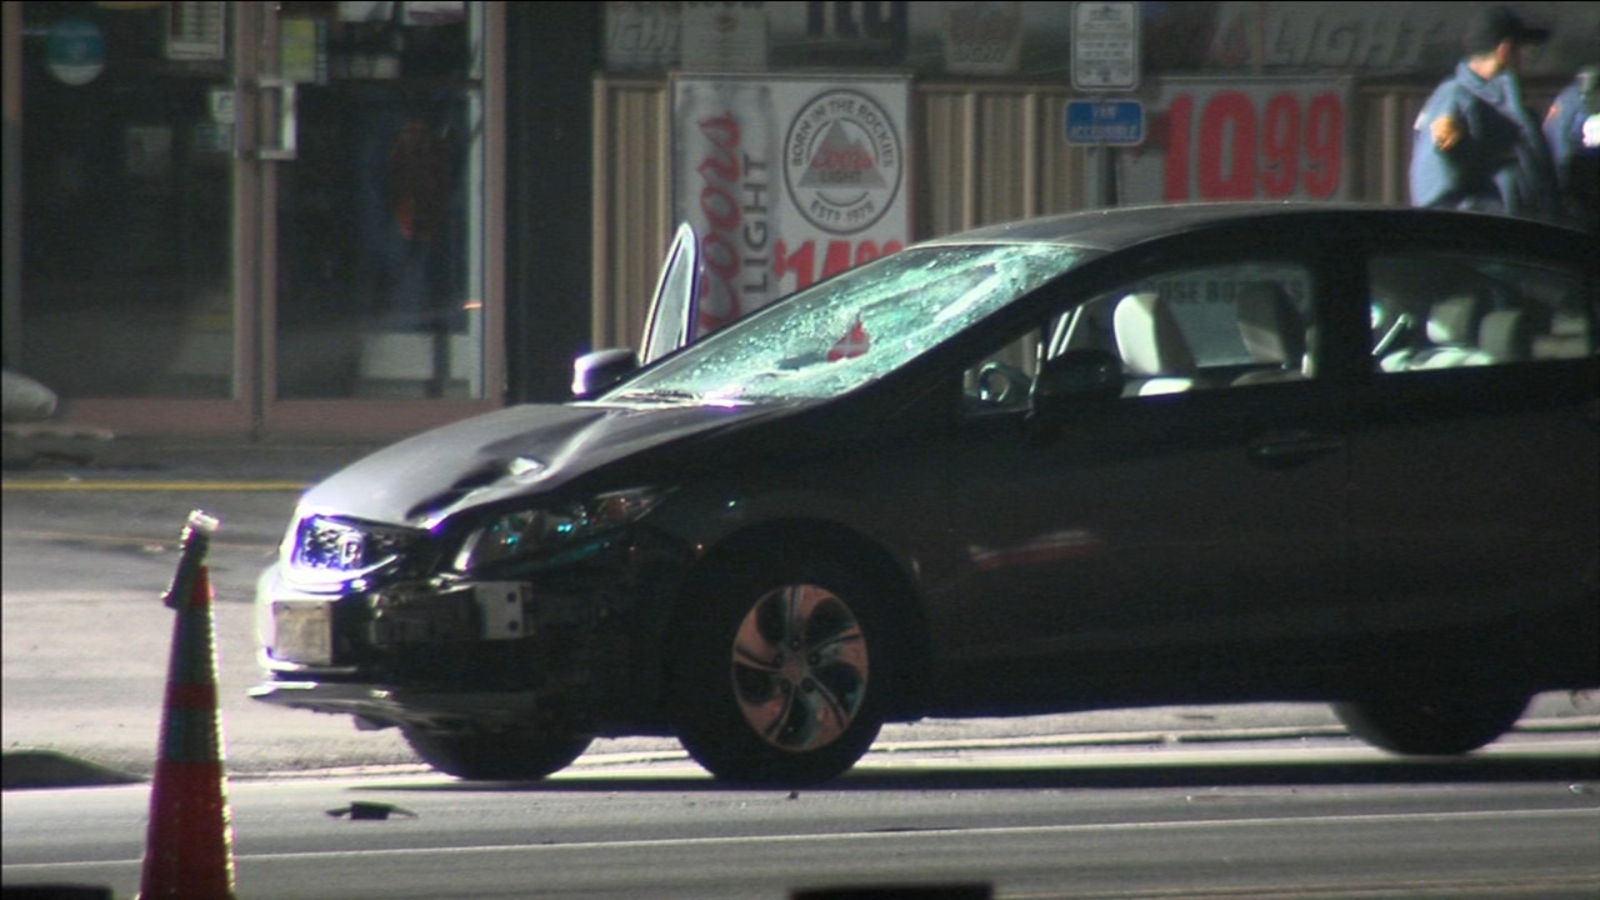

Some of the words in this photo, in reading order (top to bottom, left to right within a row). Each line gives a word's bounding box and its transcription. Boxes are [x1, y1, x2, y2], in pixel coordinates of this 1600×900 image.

[792, 119, 813, 167] BORN
[809, 104, 828, 123] IN
[829, 99, 856, 114] THE
[858, 103, 894, 169] ROCKIES
[1069, 124, 1138, 142] ACCESSIBLE
[819, 171, 863, 183] LIGHT
[696, 110, 742, 332] Coors
[744, 154, 768, 294] LIGHT
